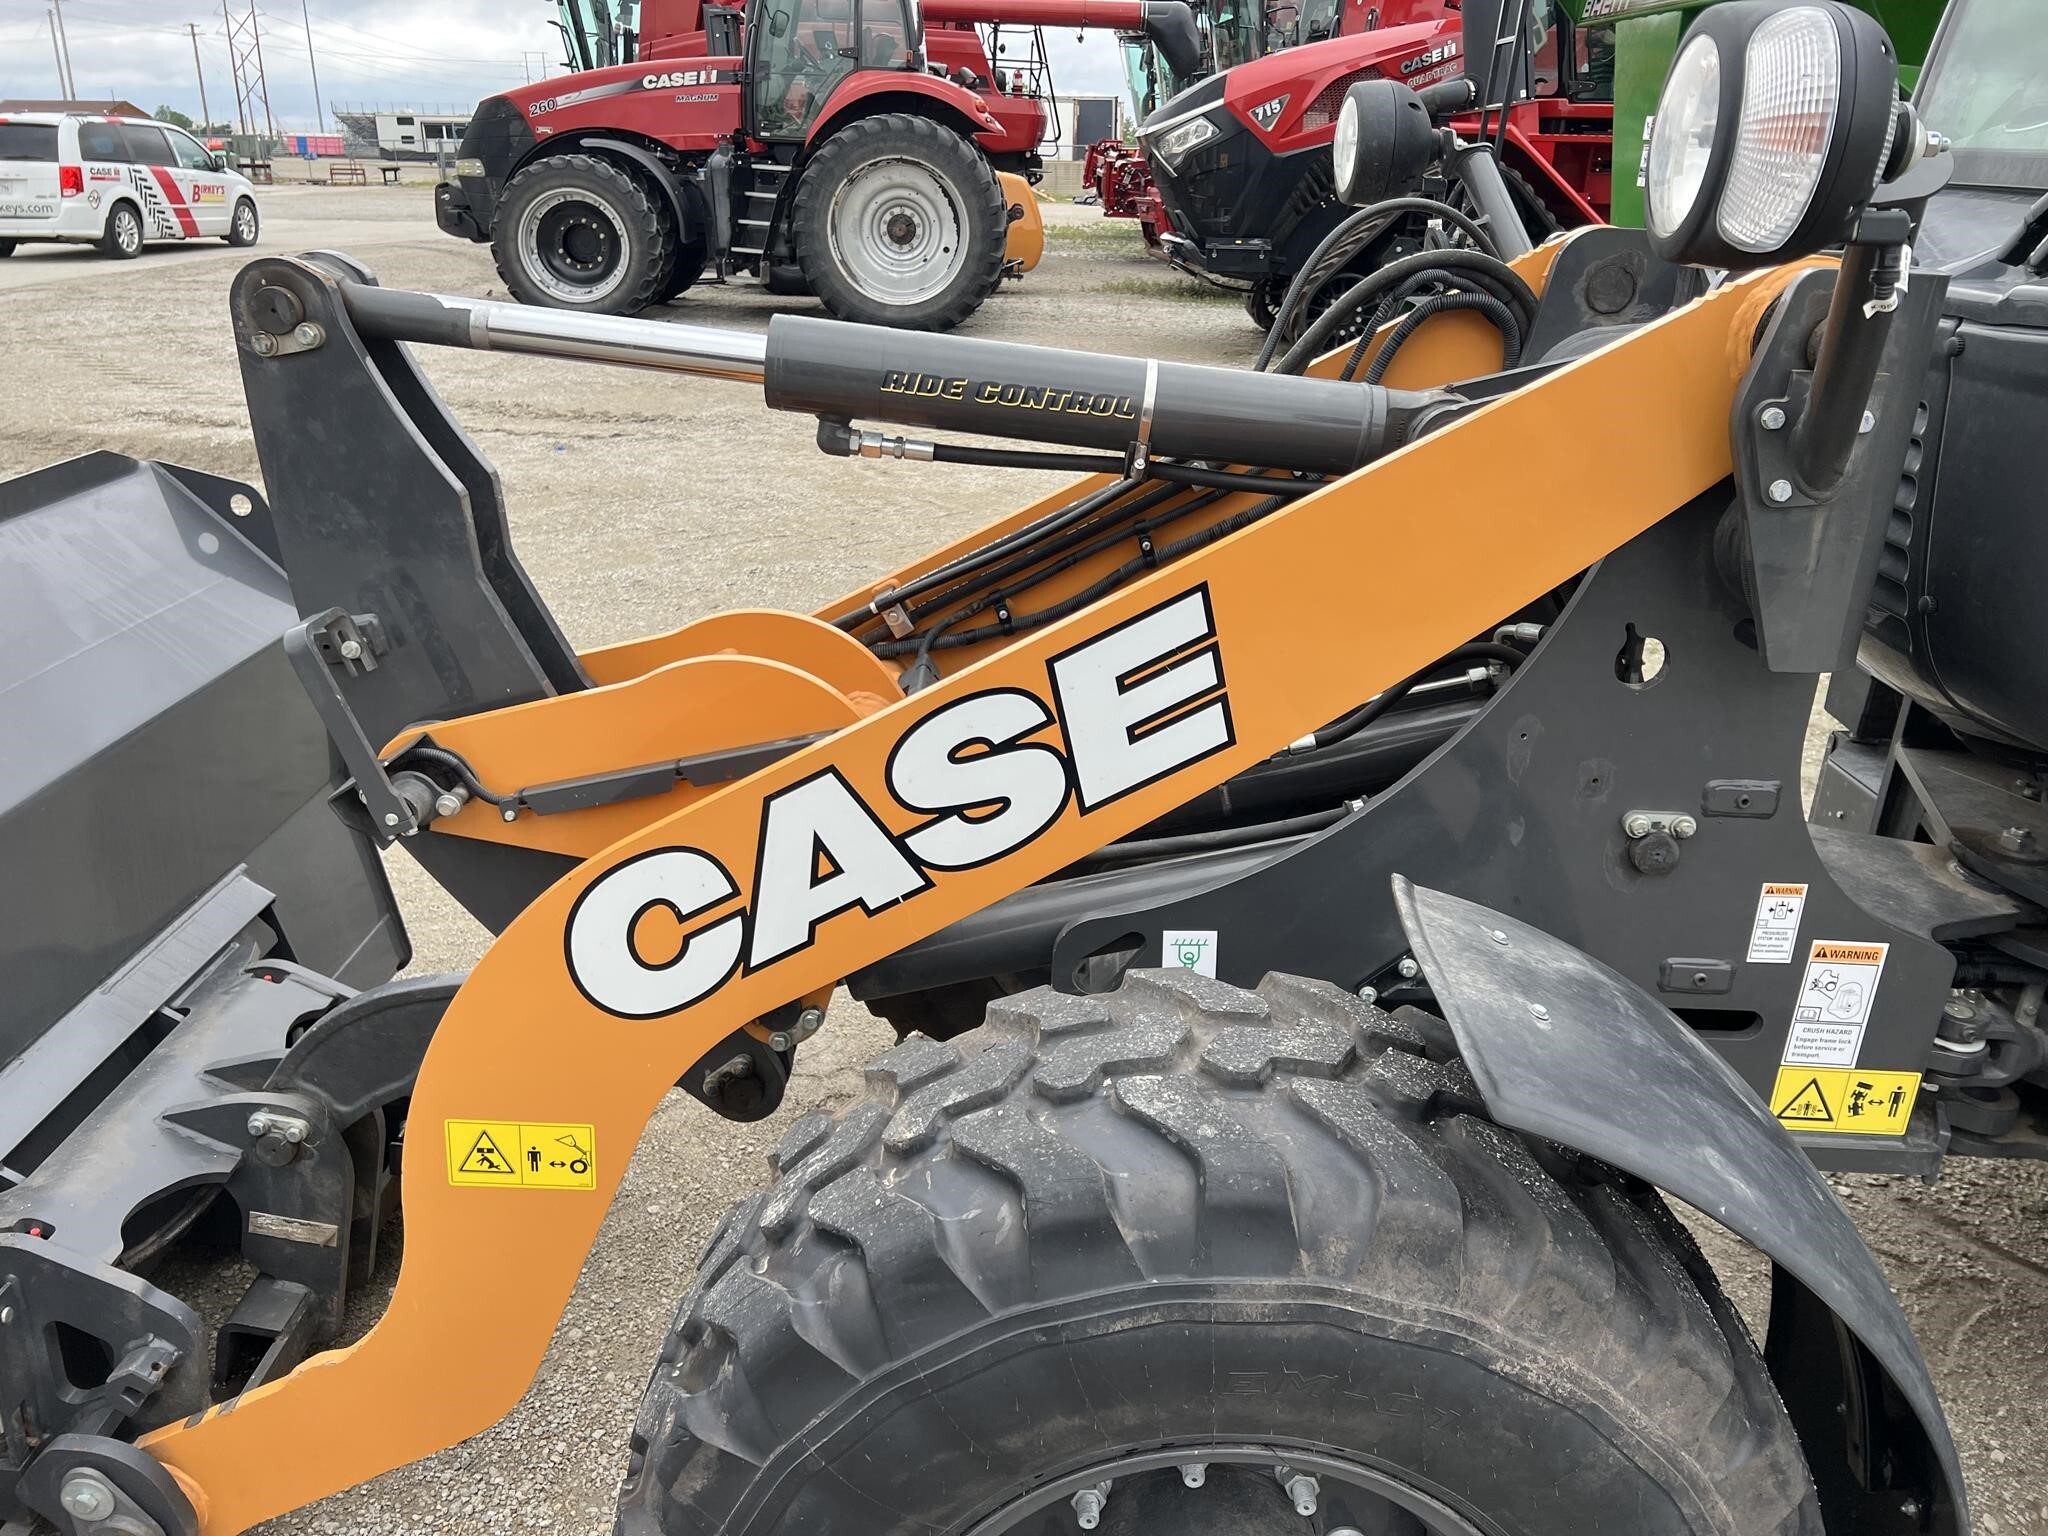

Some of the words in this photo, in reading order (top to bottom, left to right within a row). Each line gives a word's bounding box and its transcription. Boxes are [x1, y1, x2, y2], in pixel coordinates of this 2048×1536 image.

[1401, 50, 1442, 74] CASE
[642, 73, 698, 90] CASE
[1407, 63, 1458, 89] QUADTRAC
[529, 97, 557, 117] 260
[675, 94, 719, 103] MAGNUM
[1255, 99, 1281, 121] 715
[90, 167, 112, 176] CASE
[880, 370, 968, 400] RIDE
[975, 381, 1135, 419] CONTROL
[564, 581, 1236, 1020] CASE
[1775, 887, 1803, 896] WARNING
[1830, 949, 1879, 961] WARNING
[1796, 1036, 1818, 1044] Engage
